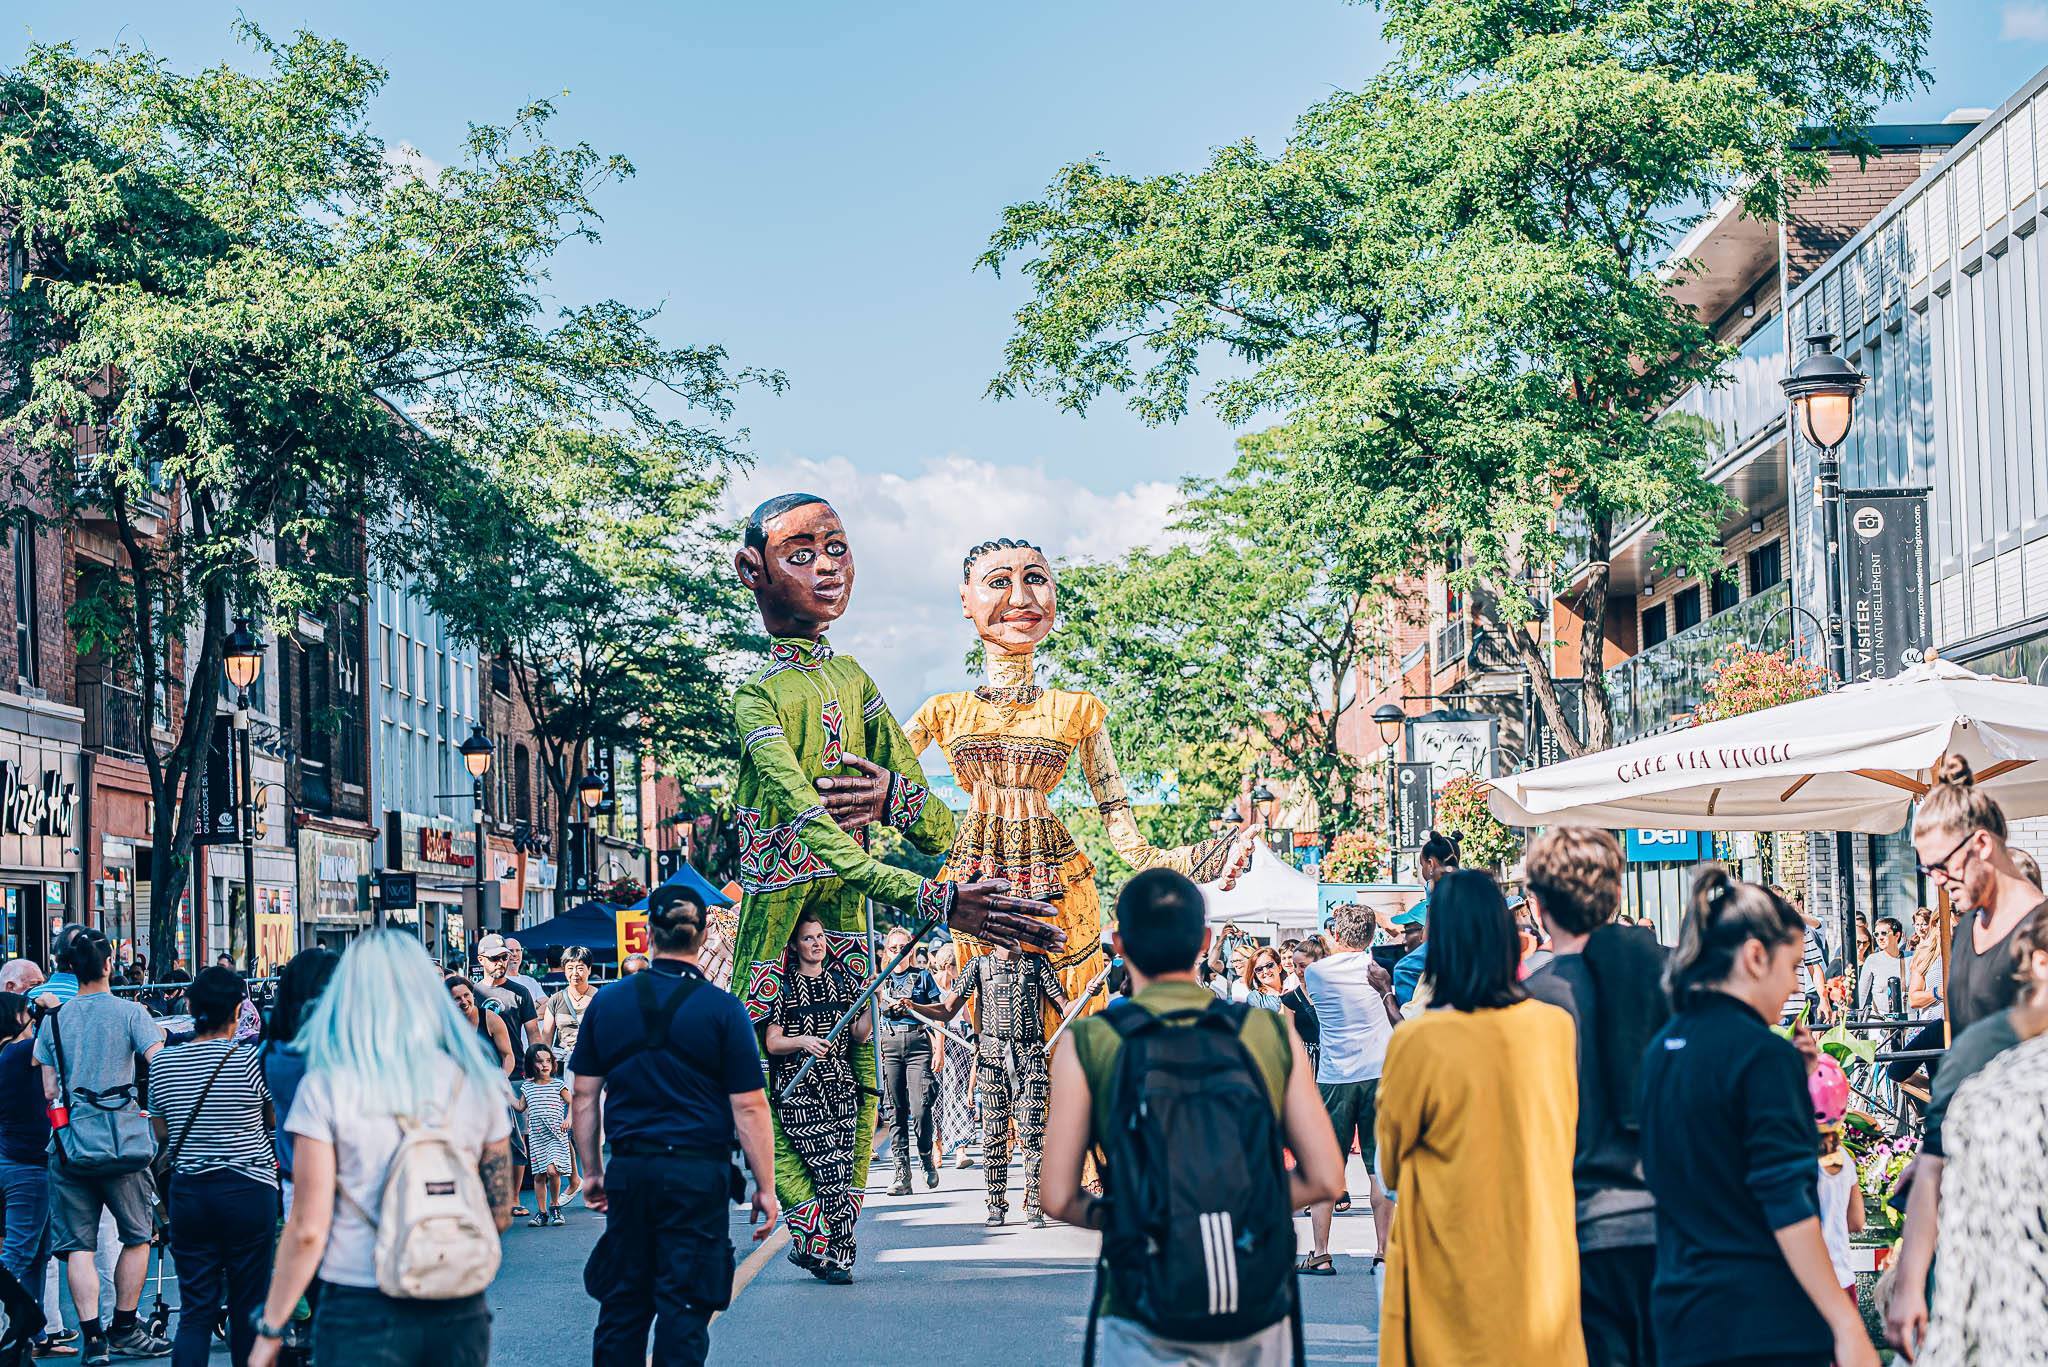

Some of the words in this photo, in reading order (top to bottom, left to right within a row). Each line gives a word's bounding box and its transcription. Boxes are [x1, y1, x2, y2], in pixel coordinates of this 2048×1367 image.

[1871, 552, 1885, 649] NATURELLEMENT
[1857, 599, 1872, 666] VISITER
[1875, 651, 1886, 680] TOUT
[1677, 750, 1710, 769] VIA
[2, 759, 47, 837] Pizza
[48, 768, 80, 837] Hut
[203, 822, 210, 834] ON
